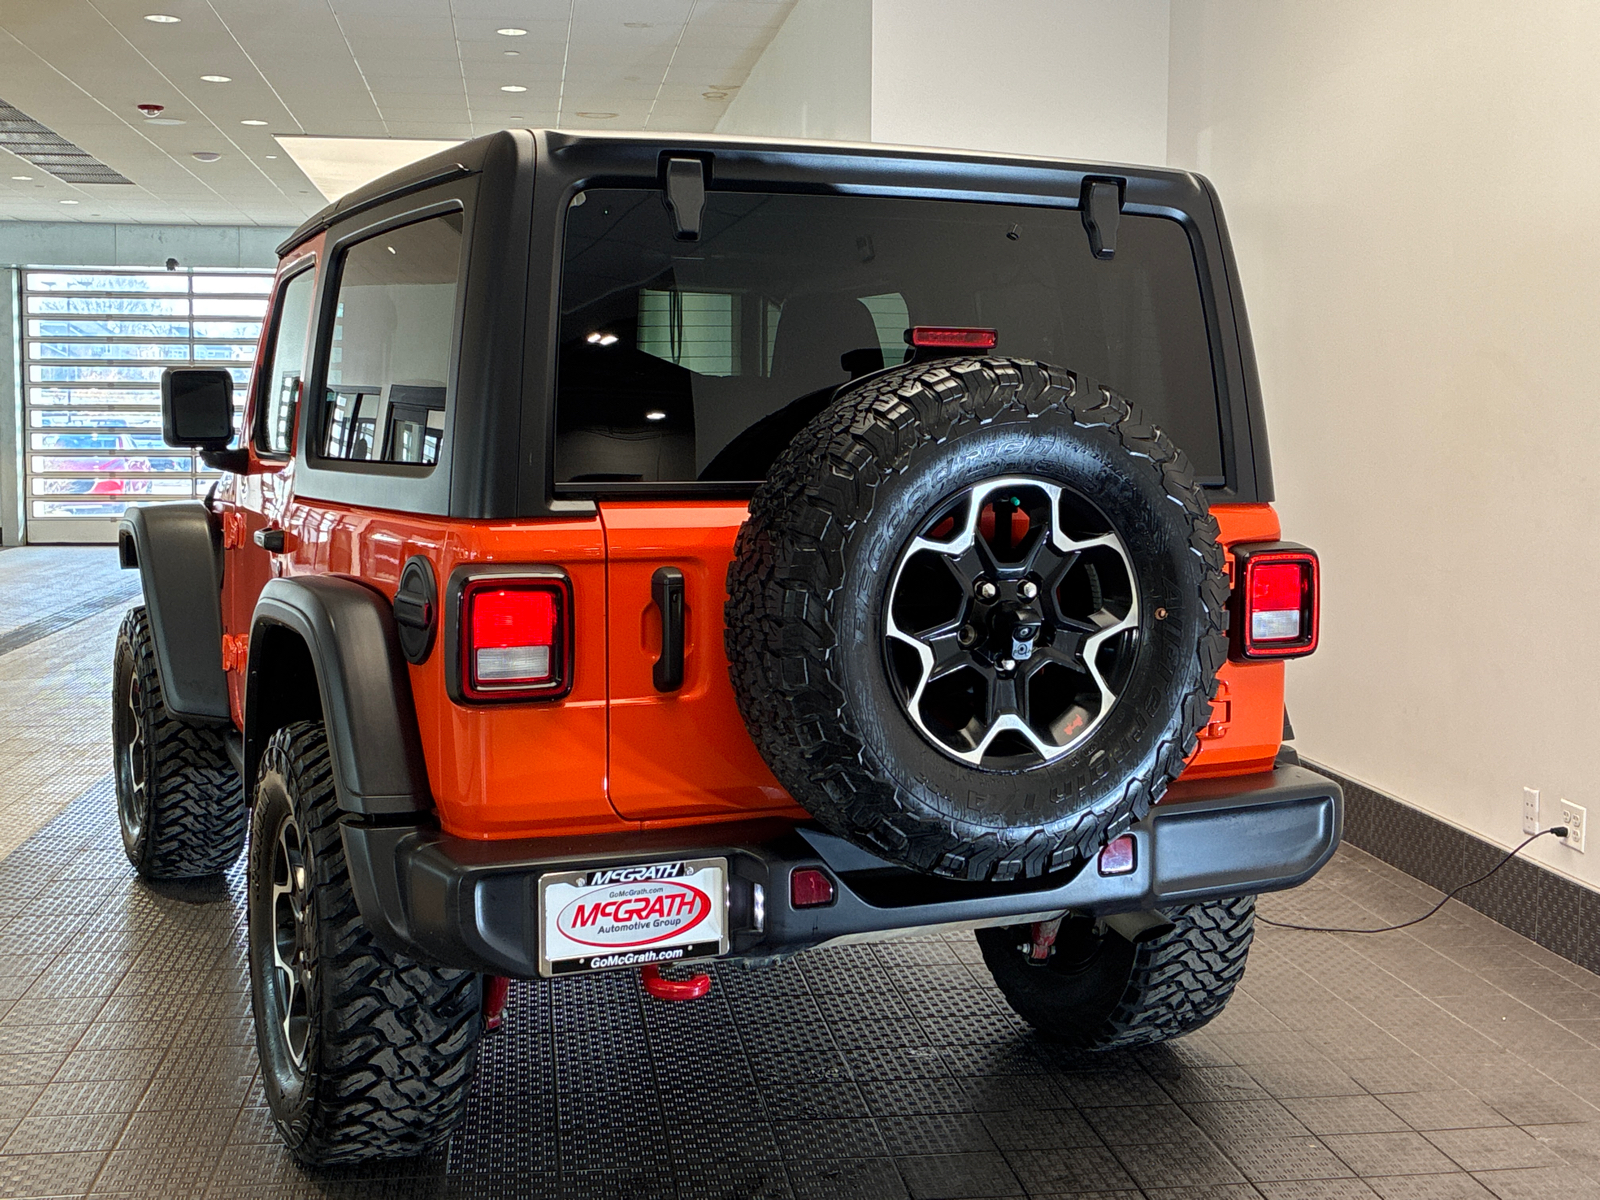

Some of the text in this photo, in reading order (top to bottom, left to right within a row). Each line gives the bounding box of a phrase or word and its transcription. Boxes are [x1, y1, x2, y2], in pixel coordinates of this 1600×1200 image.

[609, 886, 664, 898] GoMcGrath.com
[597, 917, 681, 934] Automotive Group
[591, 948, 683, 969] GoMcGrath.com
